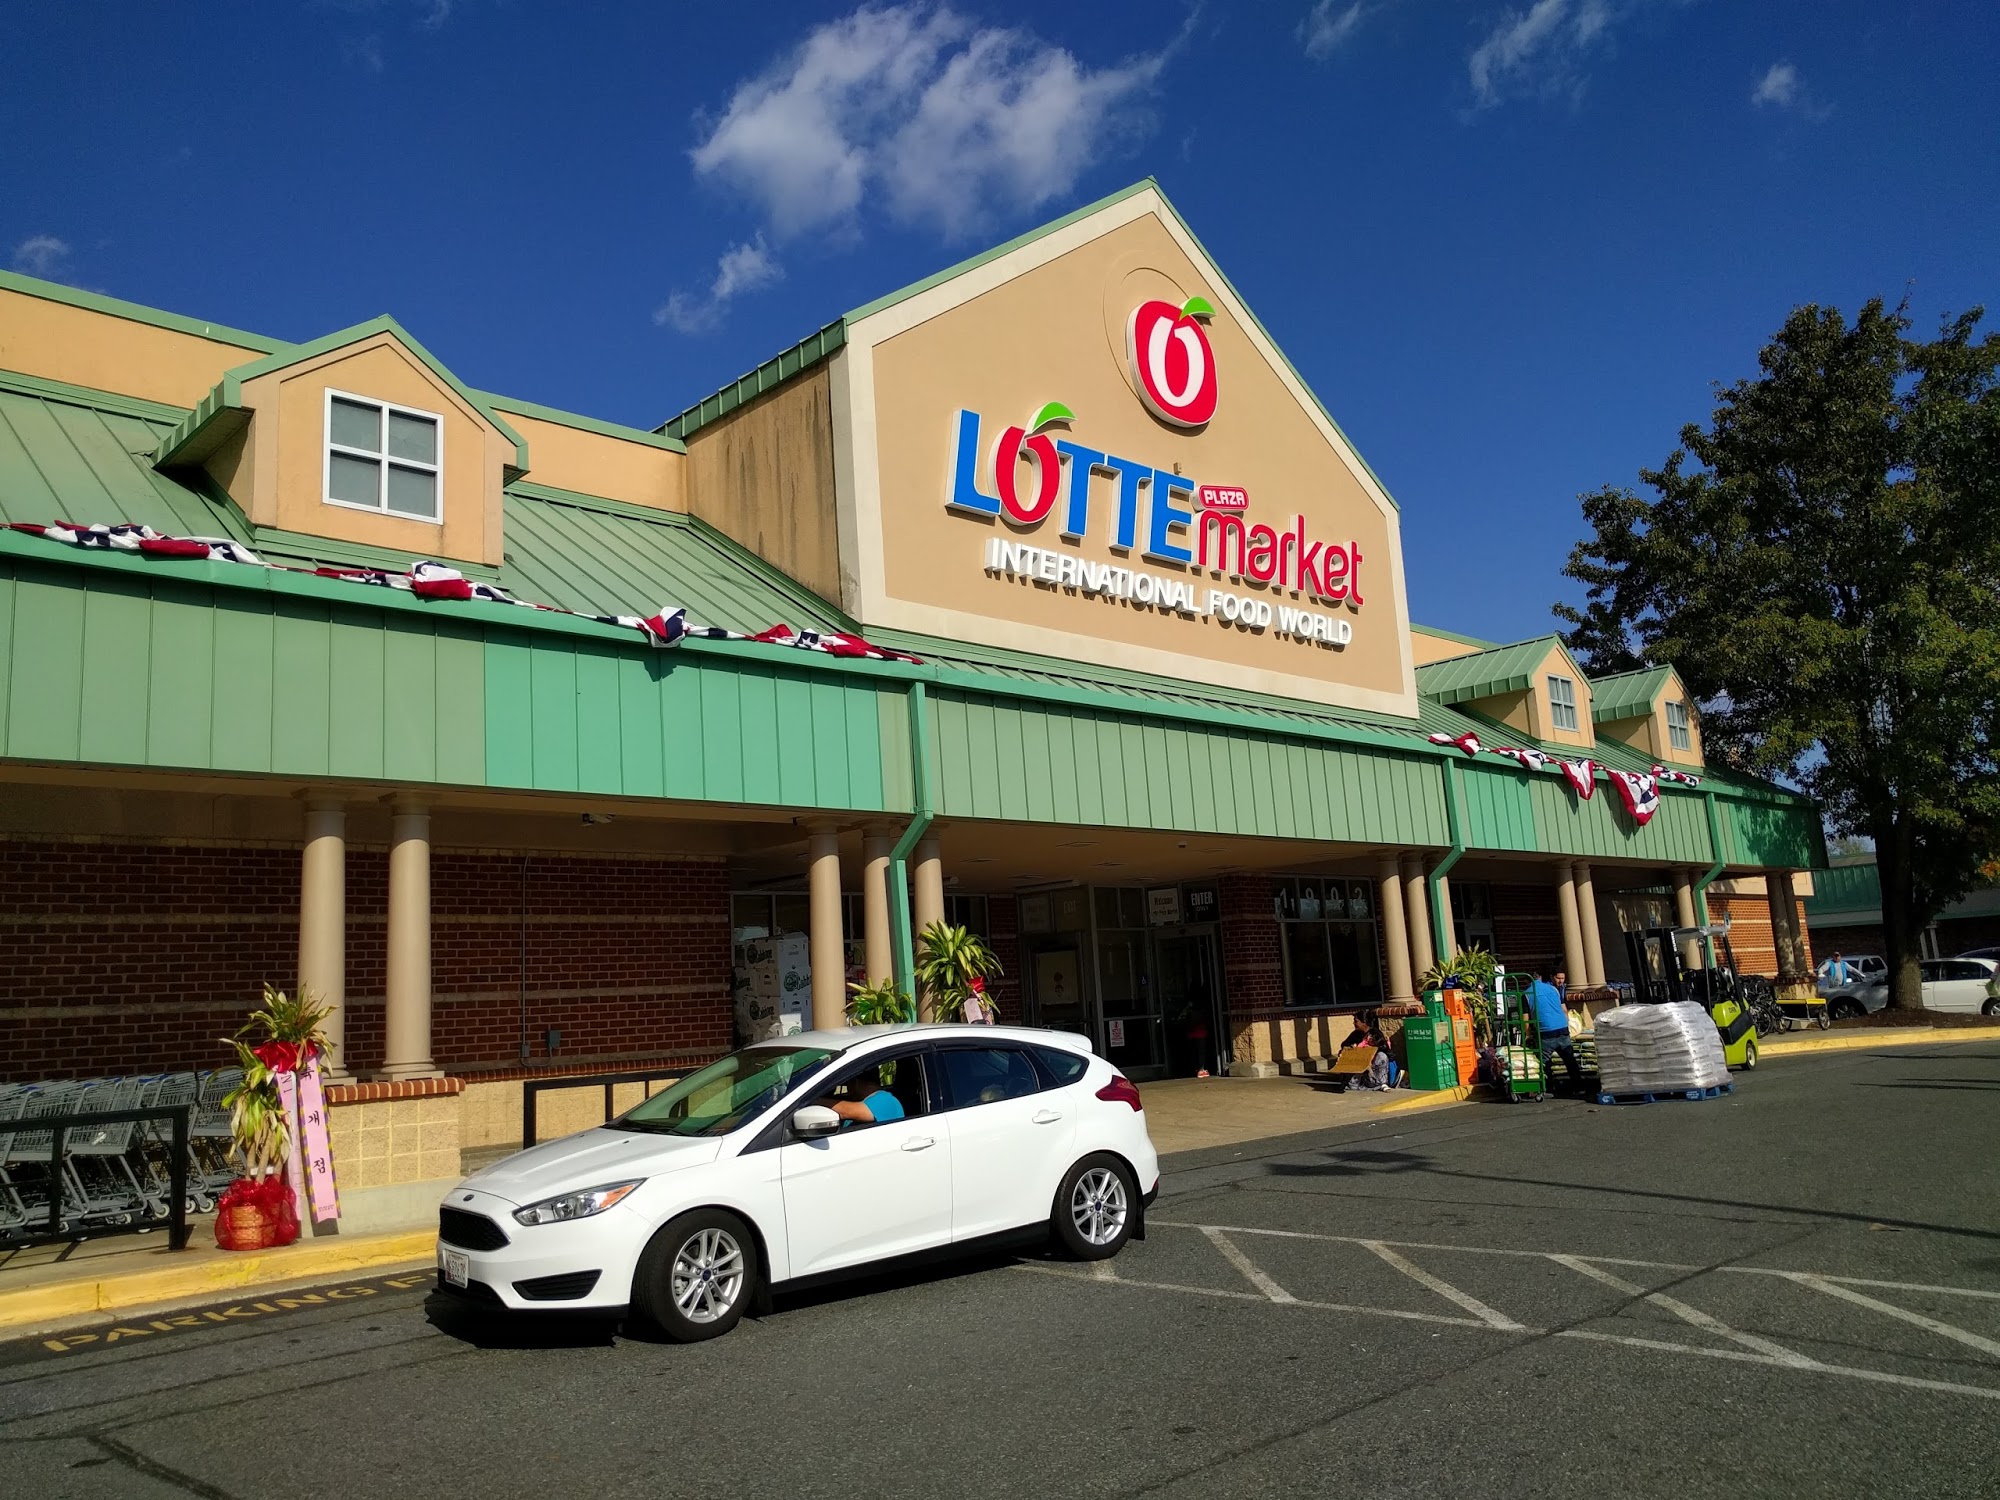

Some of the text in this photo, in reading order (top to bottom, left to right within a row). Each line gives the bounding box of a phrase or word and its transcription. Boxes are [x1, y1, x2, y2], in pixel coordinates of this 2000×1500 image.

[950, 404, 1195, 563] LOTTE
[1203, 488, 1246, 506] PLAZA
[989, 537, 1352, 646] INTERNATIONAL FOOD WORLD
[1197, 510, 1364, 606] market
[1191, 891, 1213, 906] ENTER
[42, 1286, 378, 1352] PARKING
